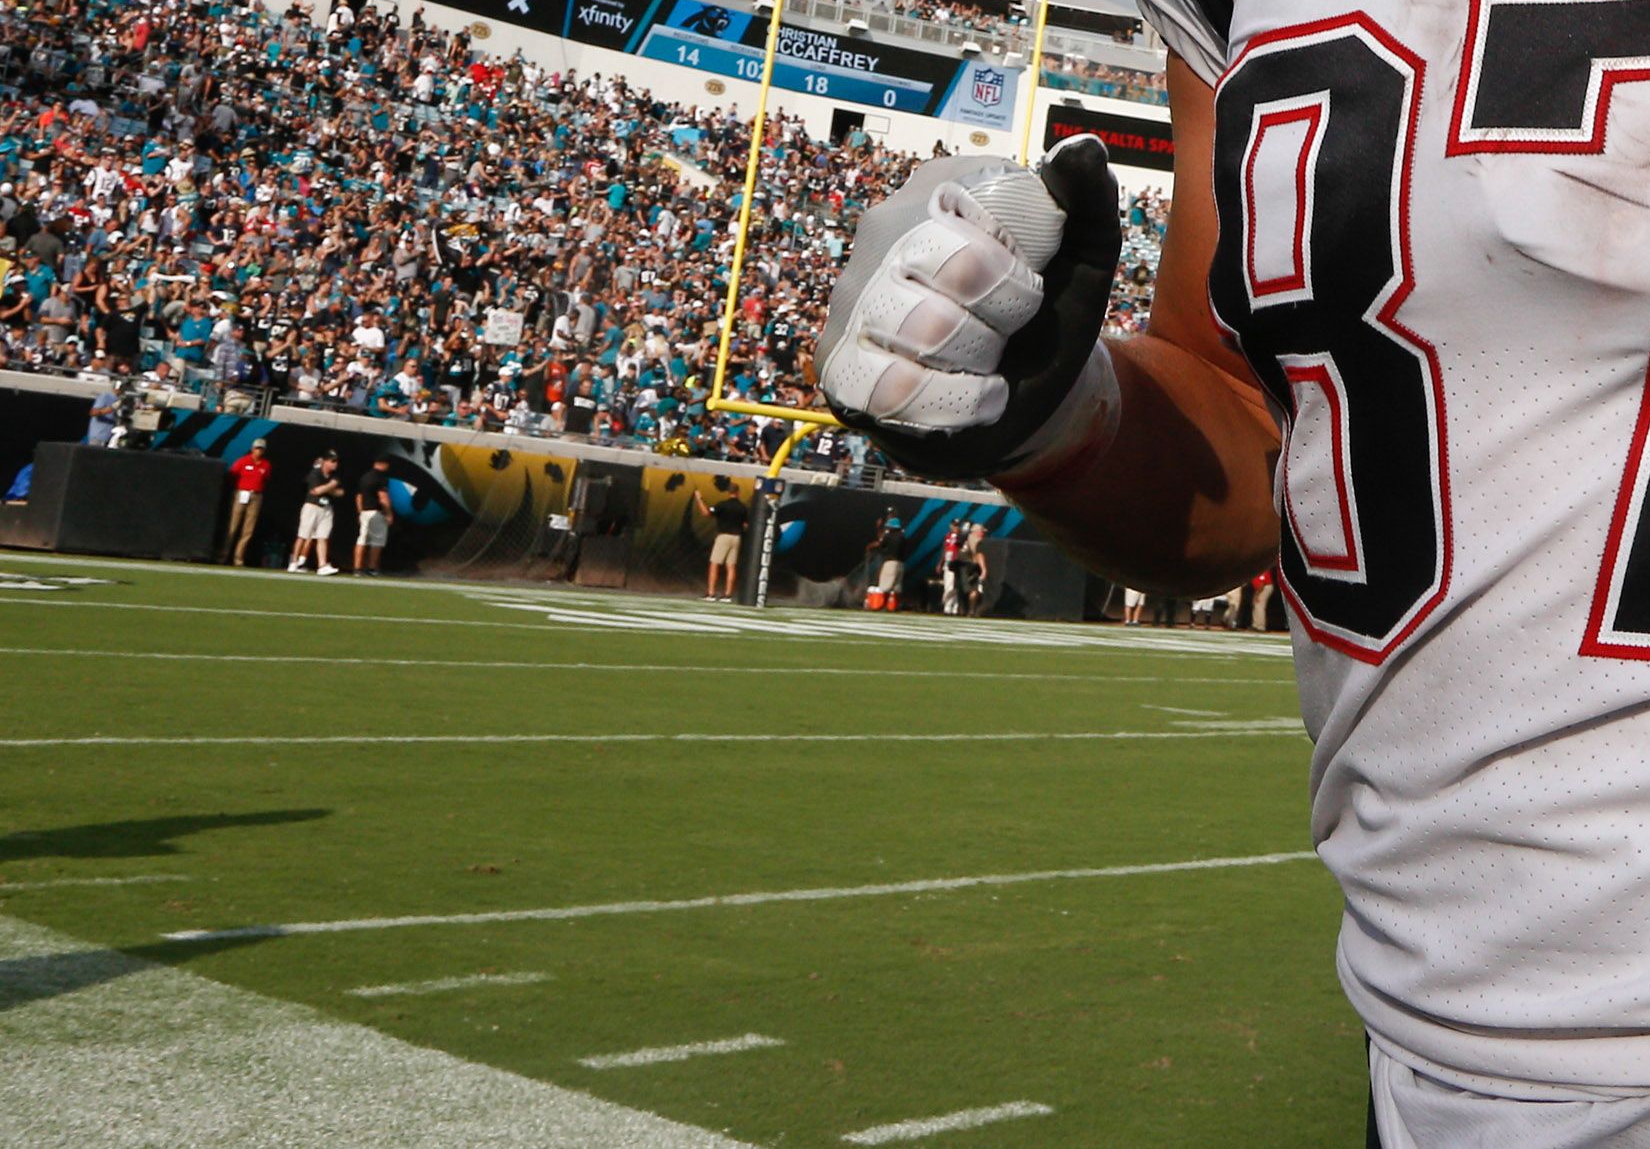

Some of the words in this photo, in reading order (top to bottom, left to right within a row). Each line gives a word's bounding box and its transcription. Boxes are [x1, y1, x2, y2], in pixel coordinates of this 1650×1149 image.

[577, 4, 634, 34] xfinity
[677, 45, 700, 66] 14
[804, 74, 829, 94] 18
[974, 83, 1000, 103] NFL
[883, 89, 897, 107] 0
[1088, 128, 1145, 150] XALTA
[817, 438, 833, 455] 12
